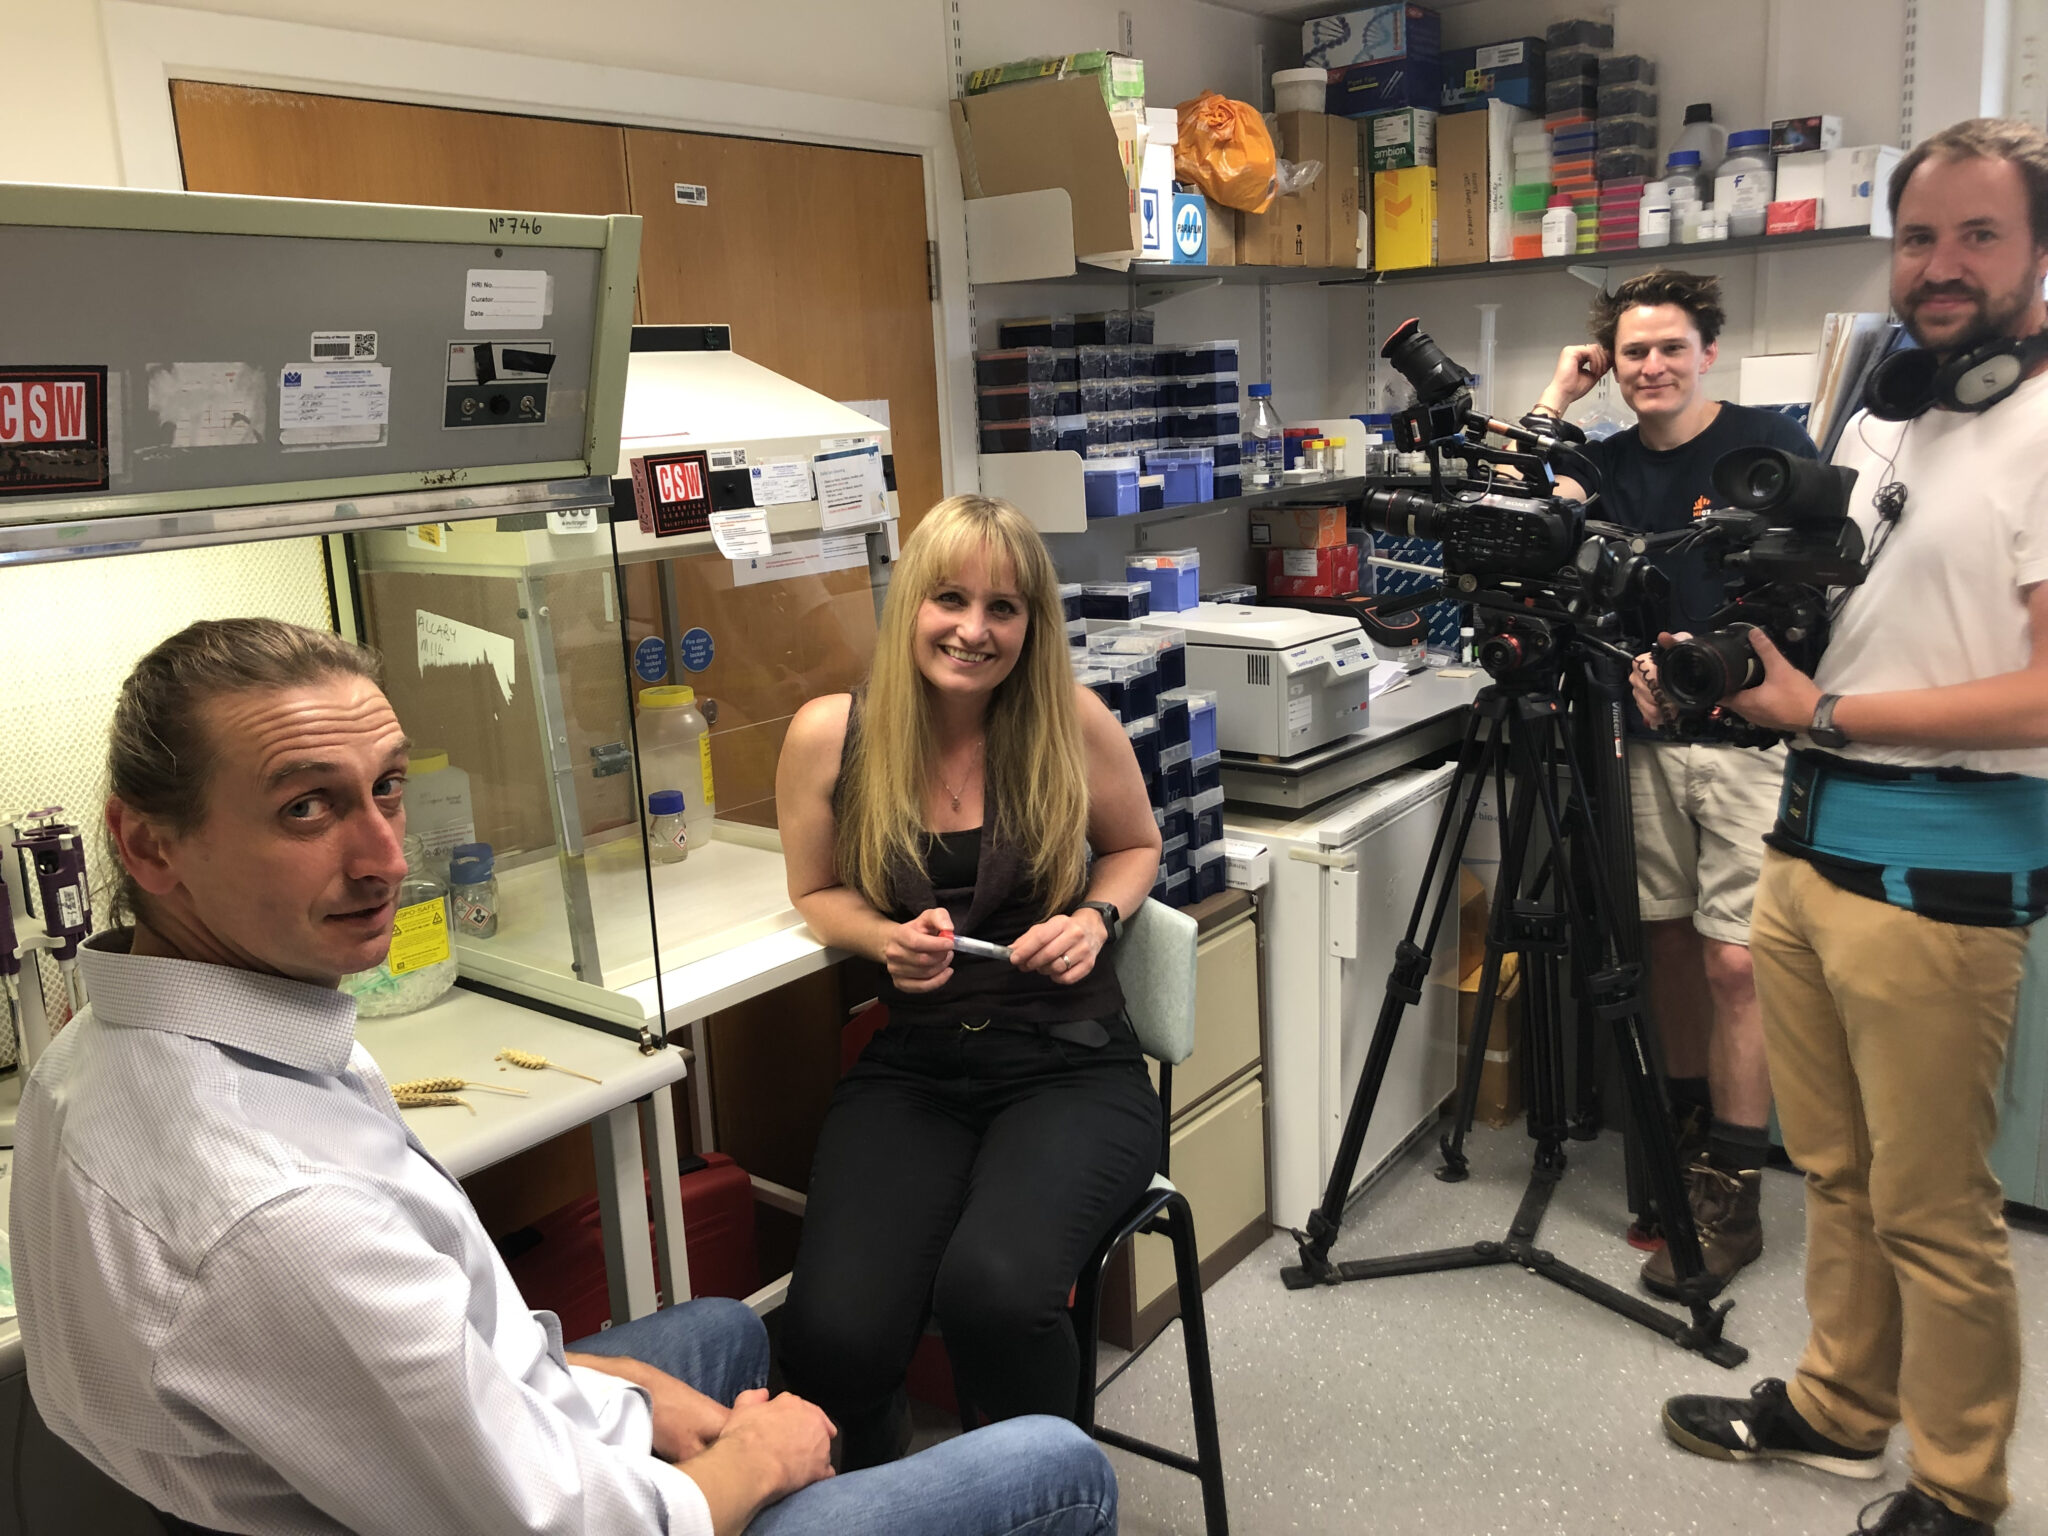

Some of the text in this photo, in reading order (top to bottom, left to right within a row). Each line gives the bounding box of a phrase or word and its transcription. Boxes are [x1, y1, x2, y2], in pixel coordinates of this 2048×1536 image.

[1374, 146, 1407, 159] ambion
[1177, 224, 1202, 234] PARAFILM
[0, 383, 84, 440] CSW
[659, 463, 702, 502] CSW
[1504, 500, 1530, 508] SONY
[1612, 701, 1621, 737] Vinten
